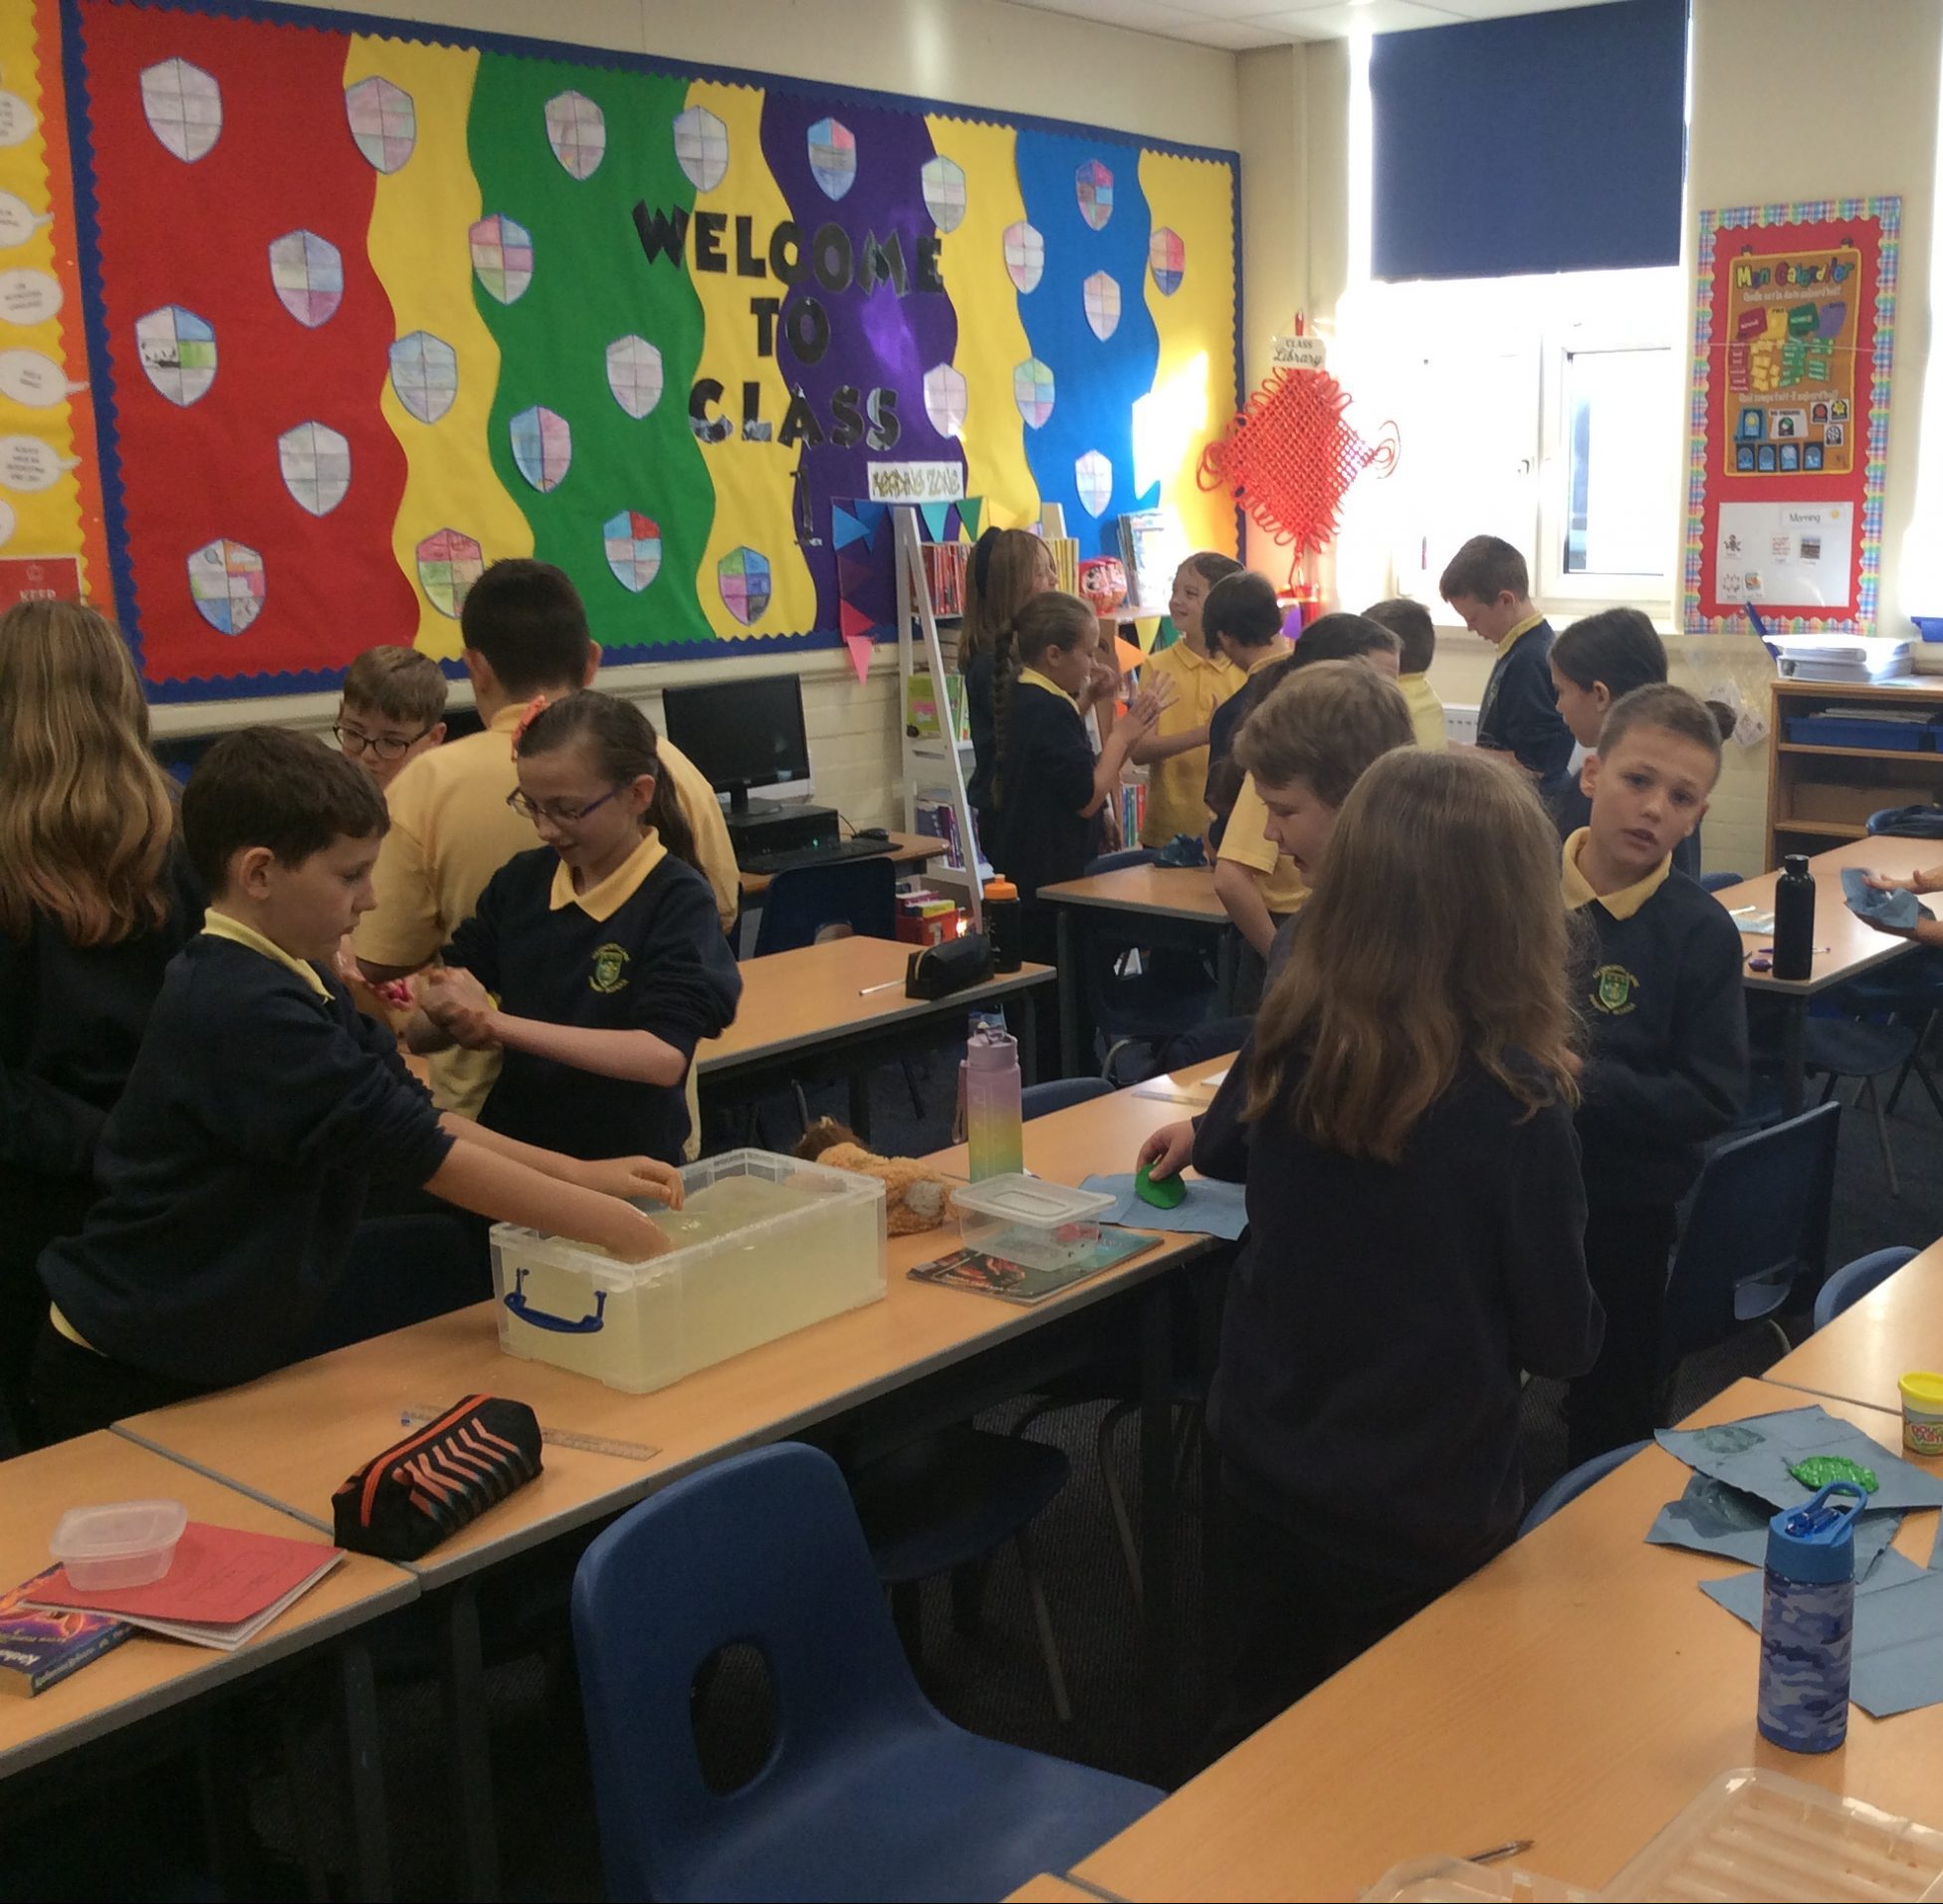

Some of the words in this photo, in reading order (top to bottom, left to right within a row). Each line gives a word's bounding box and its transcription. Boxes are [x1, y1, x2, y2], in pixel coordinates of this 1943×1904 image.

[631, 199, 945, 297] WELCOME
[751, 297, 831, 366] TO
[1272, 348, 1323, 366] Library
[688, 378, 901, 451] CLASS
